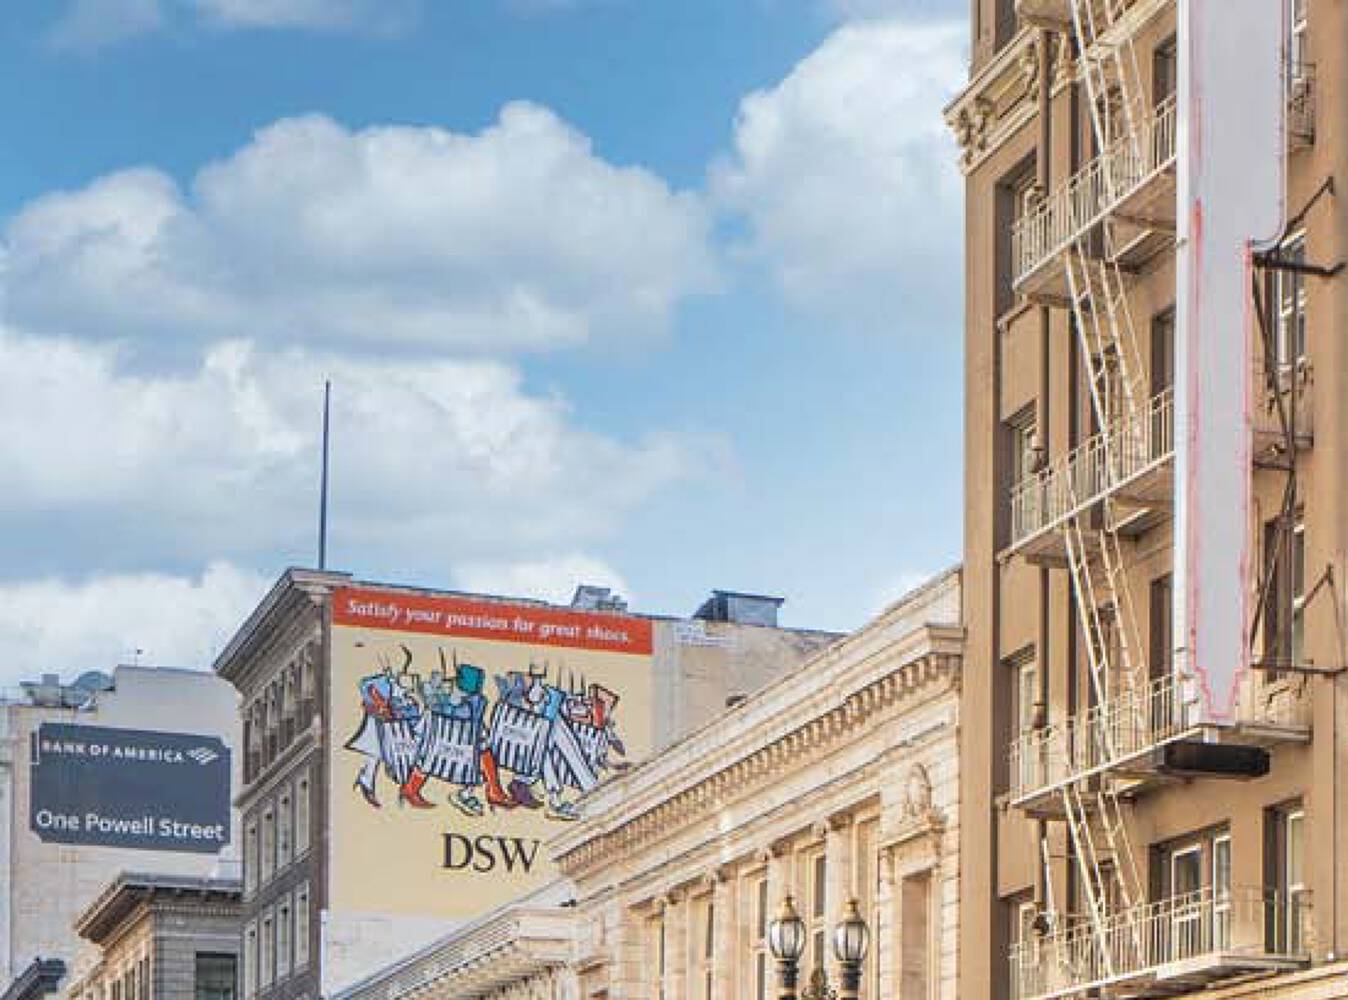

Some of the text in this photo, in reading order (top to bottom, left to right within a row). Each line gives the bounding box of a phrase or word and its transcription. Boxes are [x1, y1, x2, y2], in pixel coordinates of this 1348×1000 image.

[348, 600, 401, 622] Satisfy
[406, 606, 441, 625] your
[445, 613, 509, 631] passion
[513, 618, 535, 633] for
[538, 622, 581, 641] great
[41, 740, 183, 763] BANK OF AMERICA
[36, 808, 225, 841] One Powell Street
[440, 832, 541, 873] DSW
